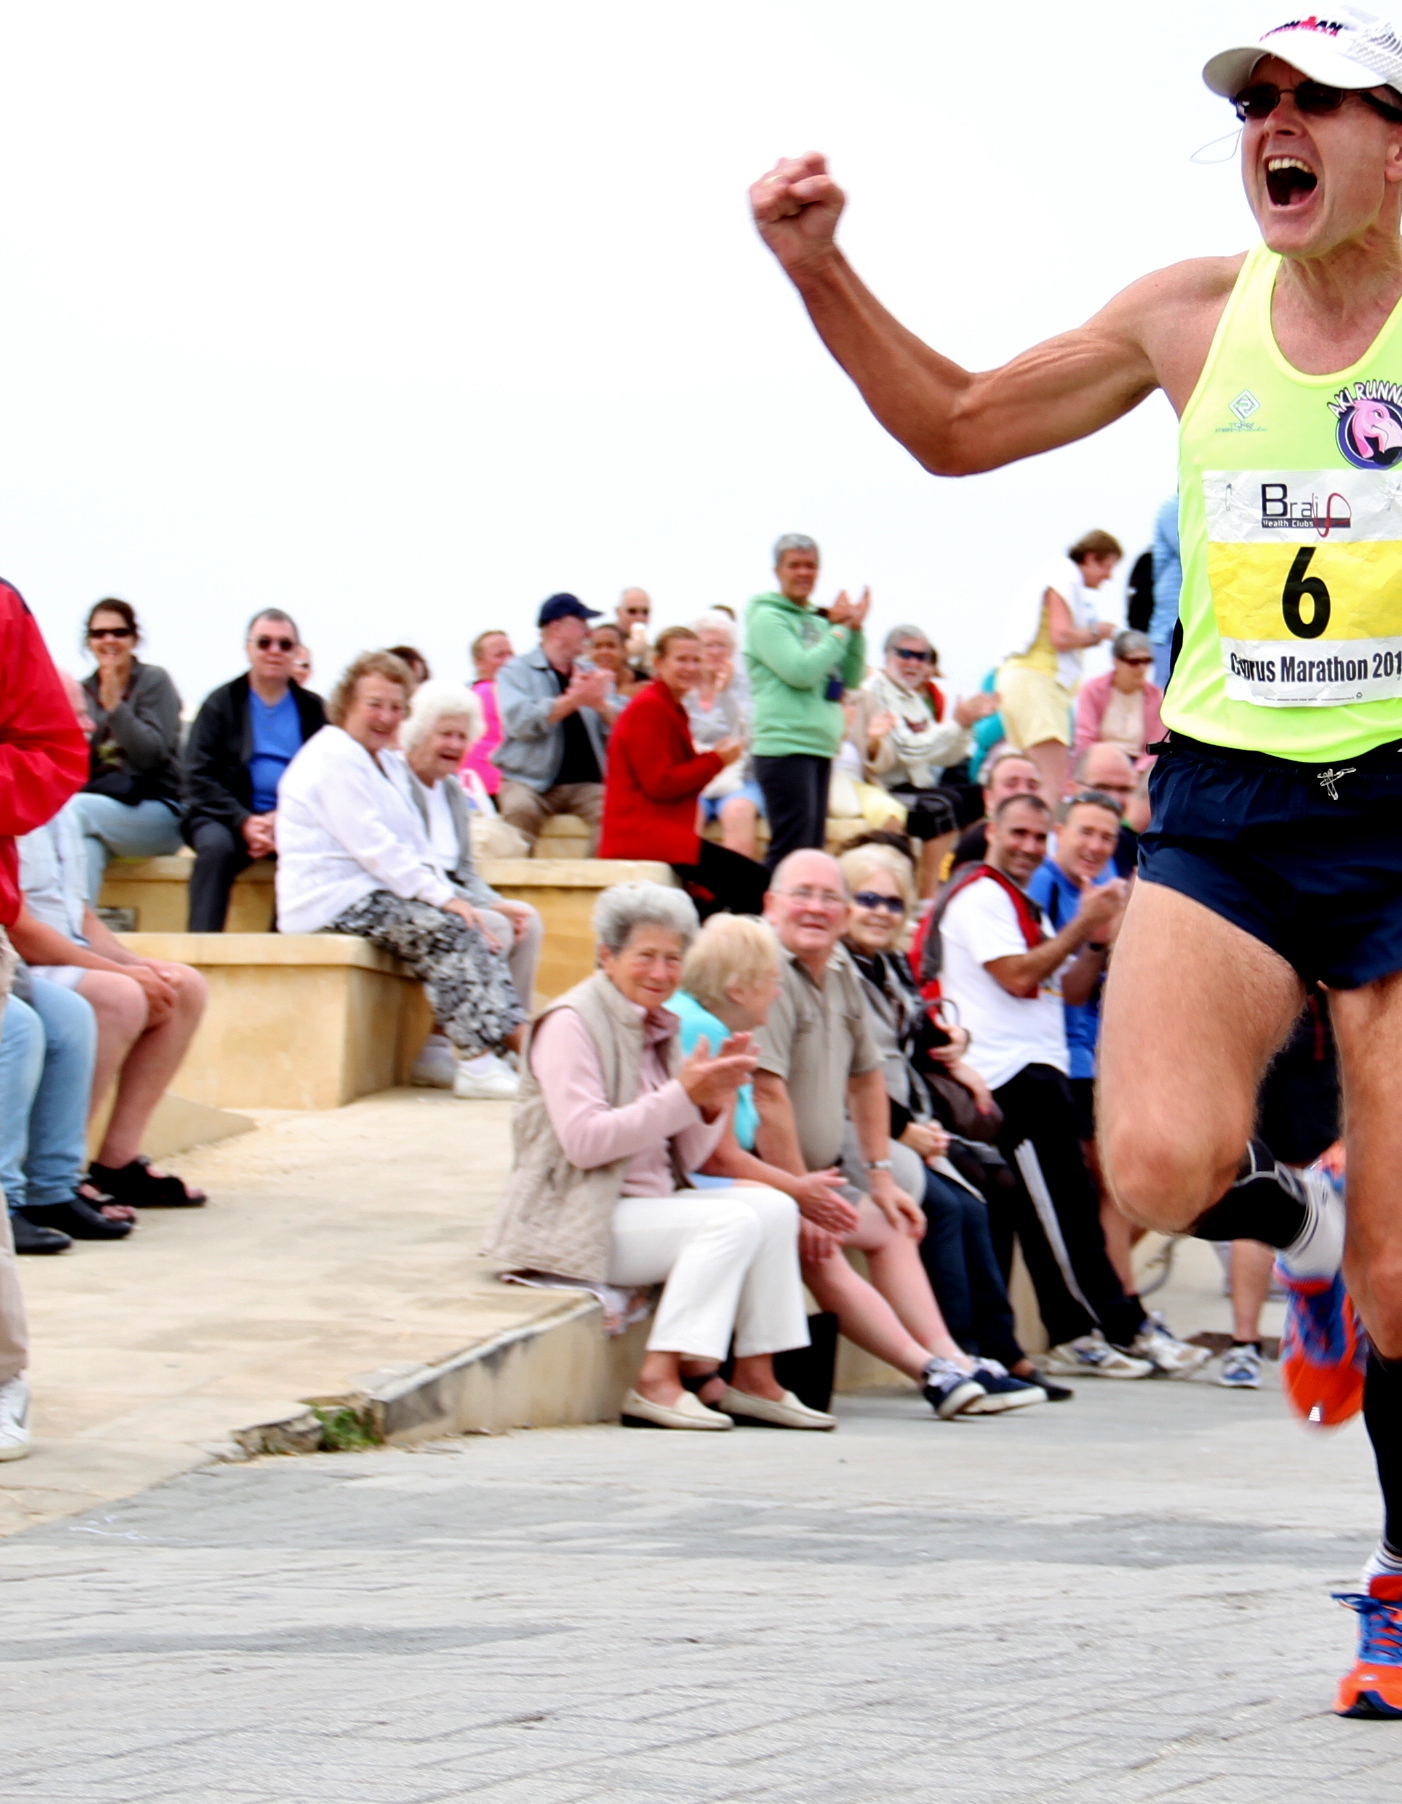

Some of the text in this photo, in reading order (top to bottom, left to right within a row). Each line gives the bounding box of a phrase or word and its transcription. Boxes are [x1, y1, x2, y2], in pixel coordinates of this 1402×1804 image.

[1327, 387, 1355, 419] AKI
[1262, 520, 1314, 528] Health Clubs
[1282, 547, 1331, 639] 6
[1280, 656, 1368, 682] Marathon
